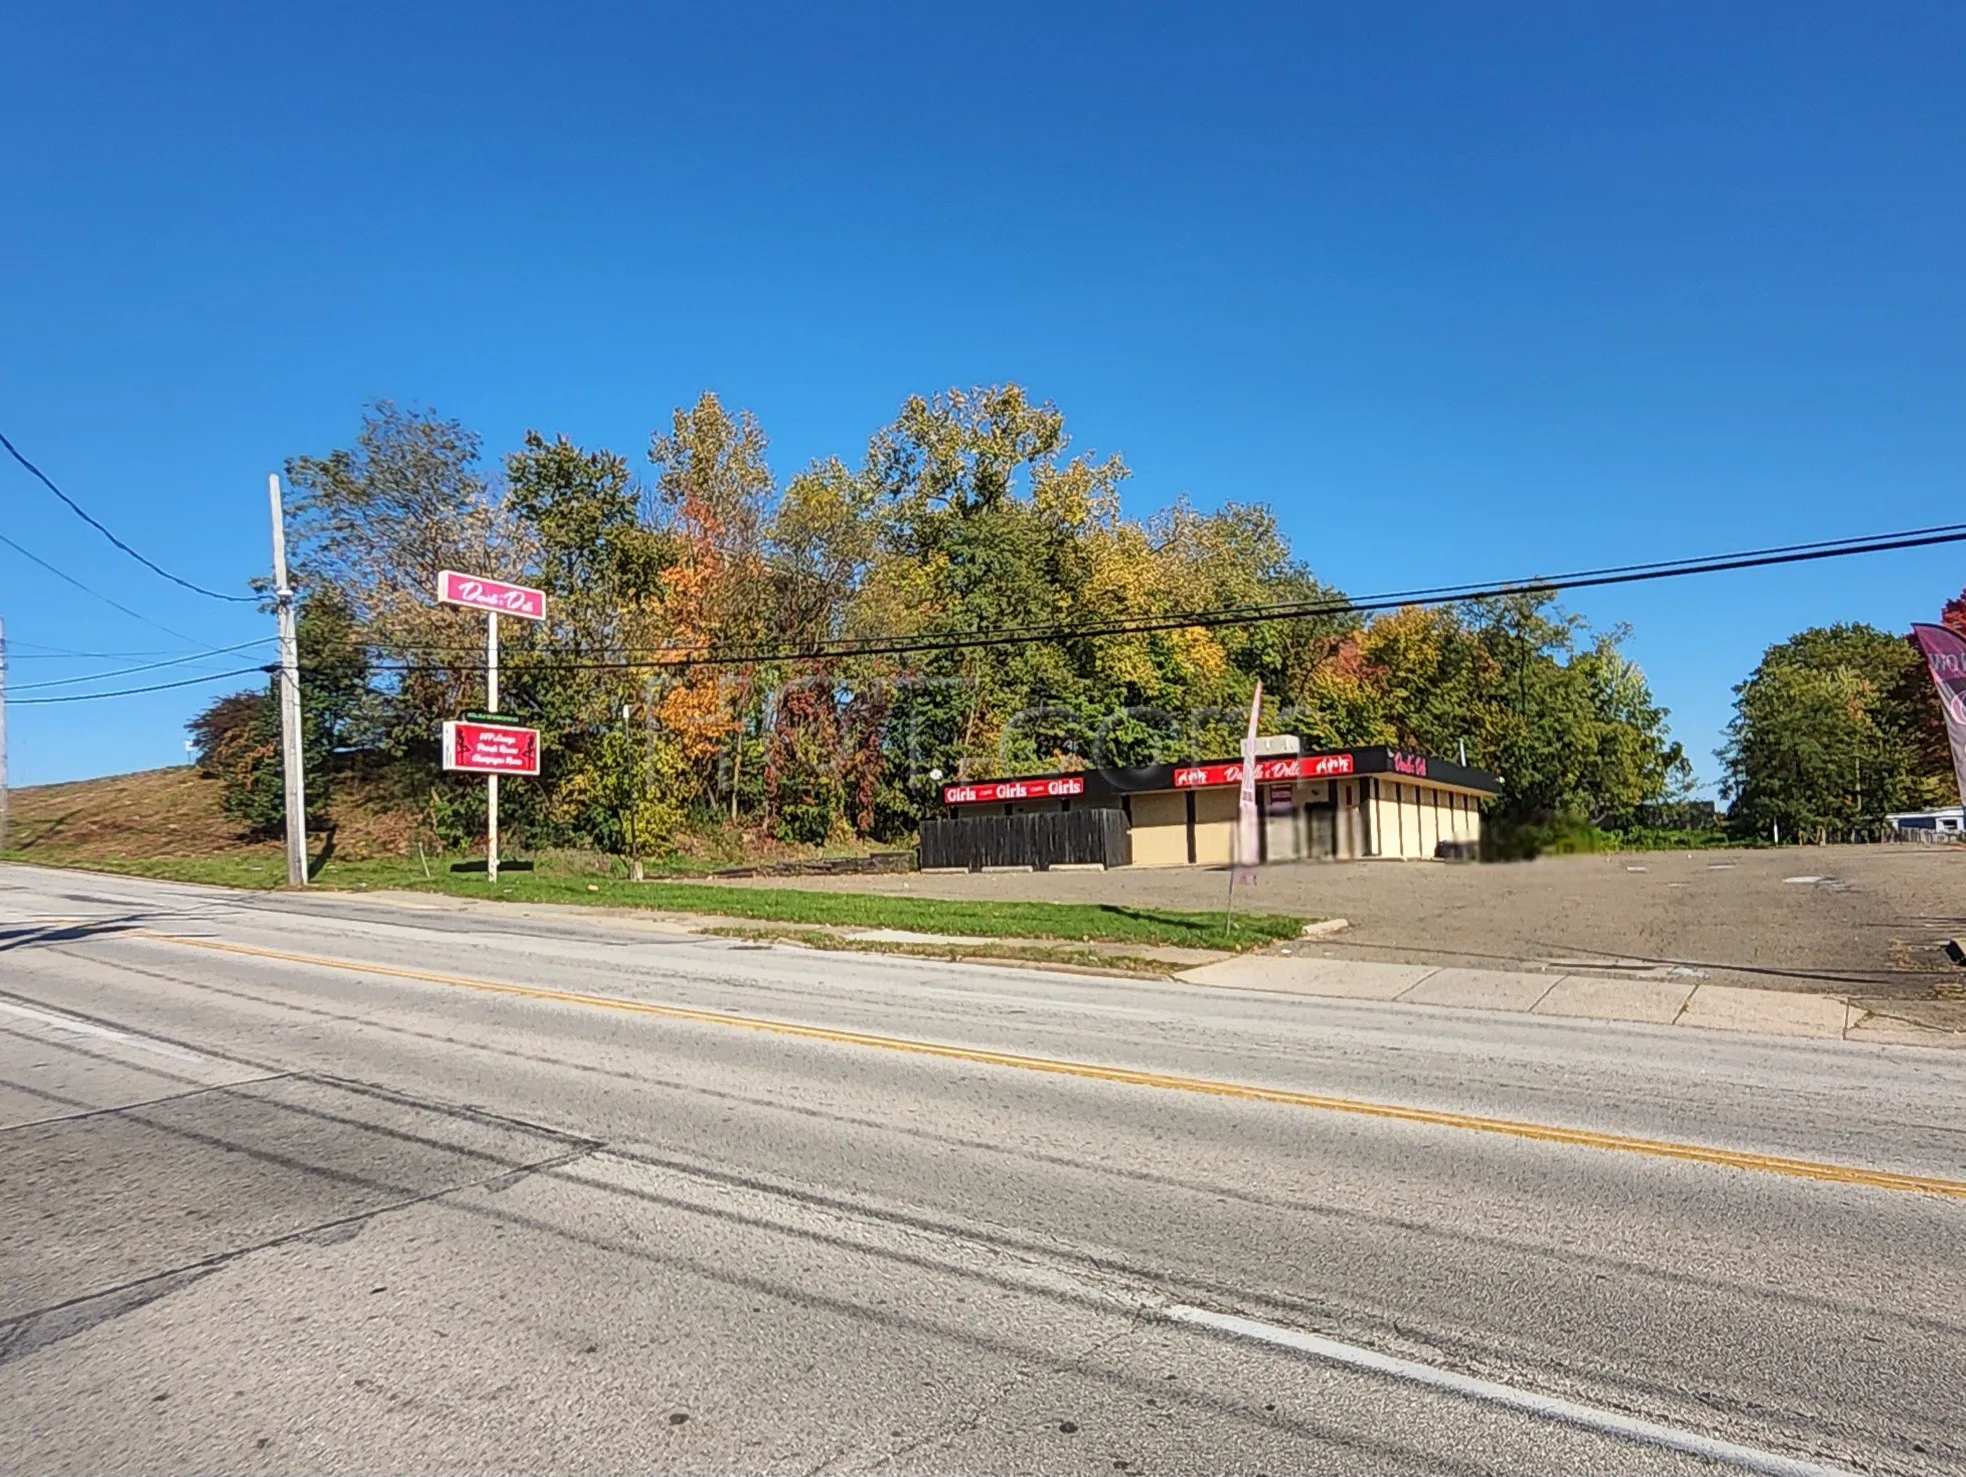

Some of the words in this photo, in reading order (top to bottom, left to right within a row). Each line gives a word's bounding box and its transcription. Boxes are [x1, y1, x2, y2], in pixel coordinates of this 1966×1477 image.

[946, 787, 976, 802] Girls
[996, 783, 1027, 799] Girls
[1048, 779, 1081, 795] Girls
